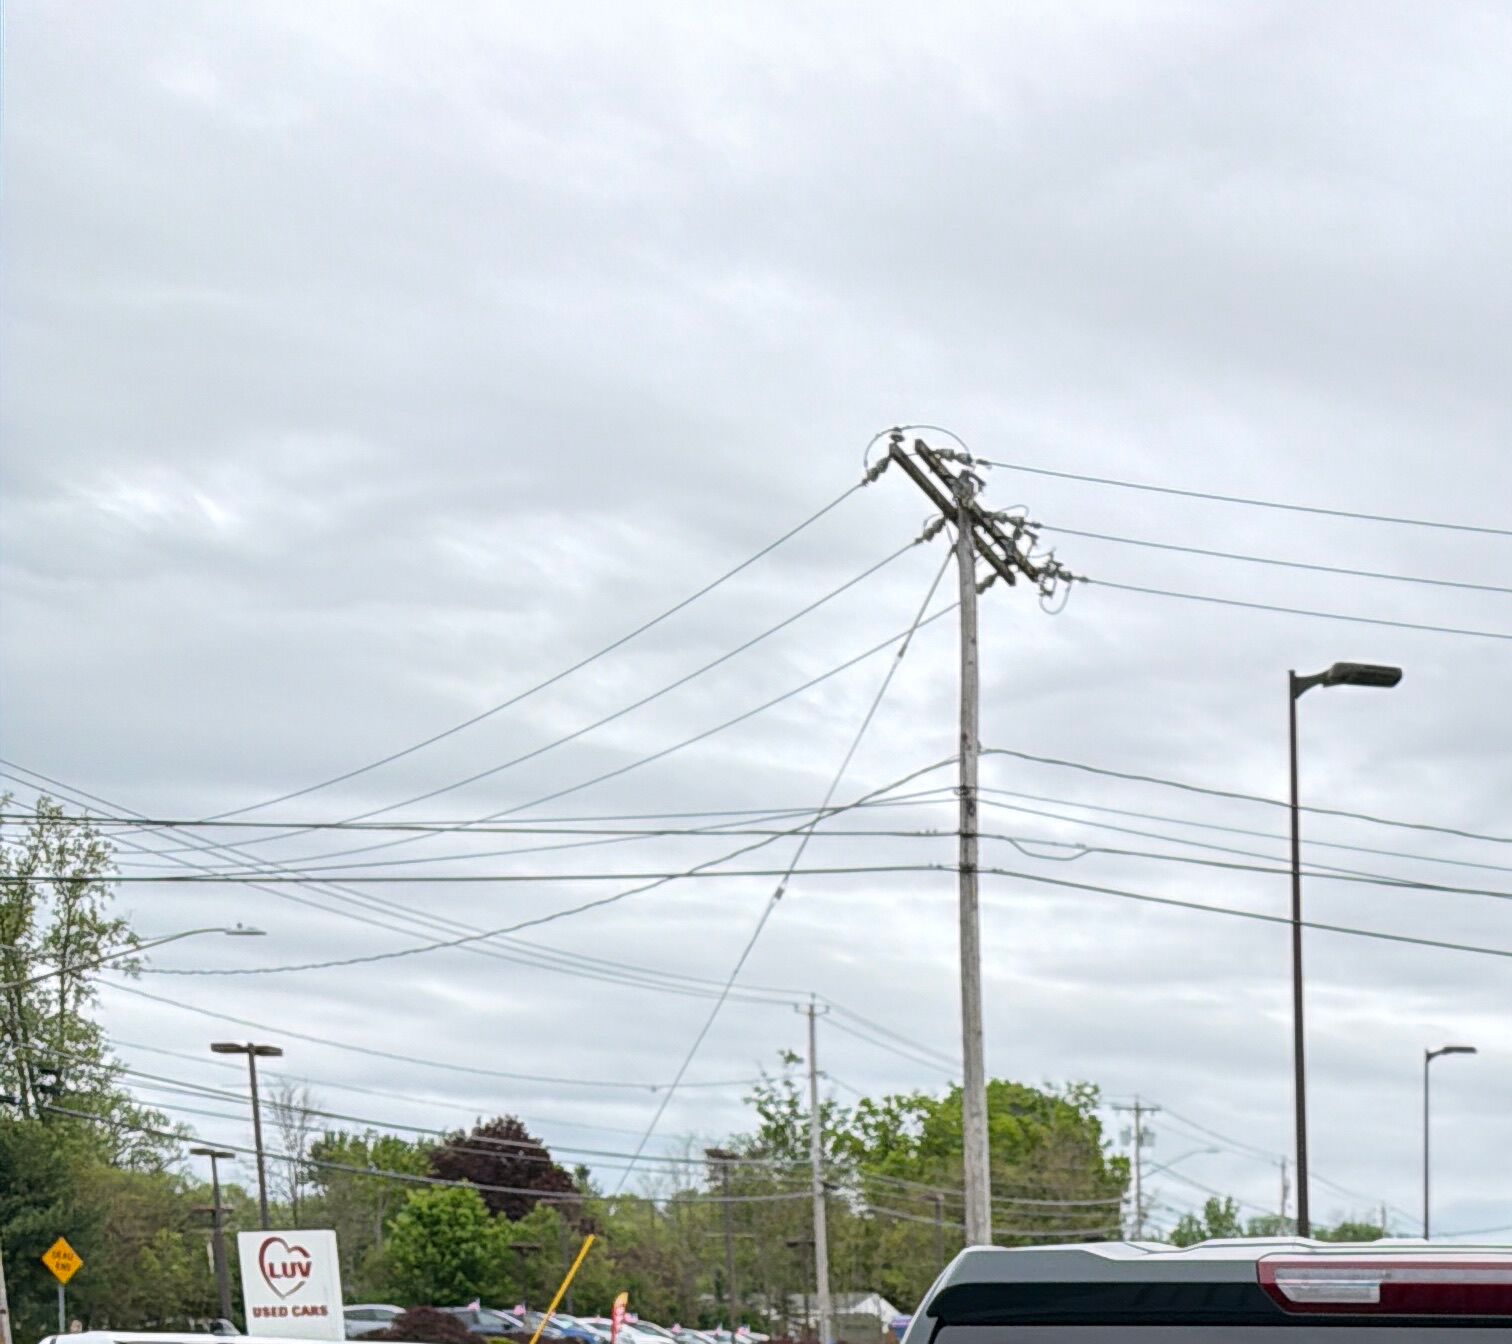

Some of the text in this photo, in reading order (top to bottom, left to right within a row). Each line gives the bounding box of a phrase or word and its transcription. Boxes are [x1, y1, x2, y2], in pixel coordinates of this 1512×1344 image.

[268, 1261, 312, 1279] LUV
[252, 1305, 328, 1318] USED CARS
